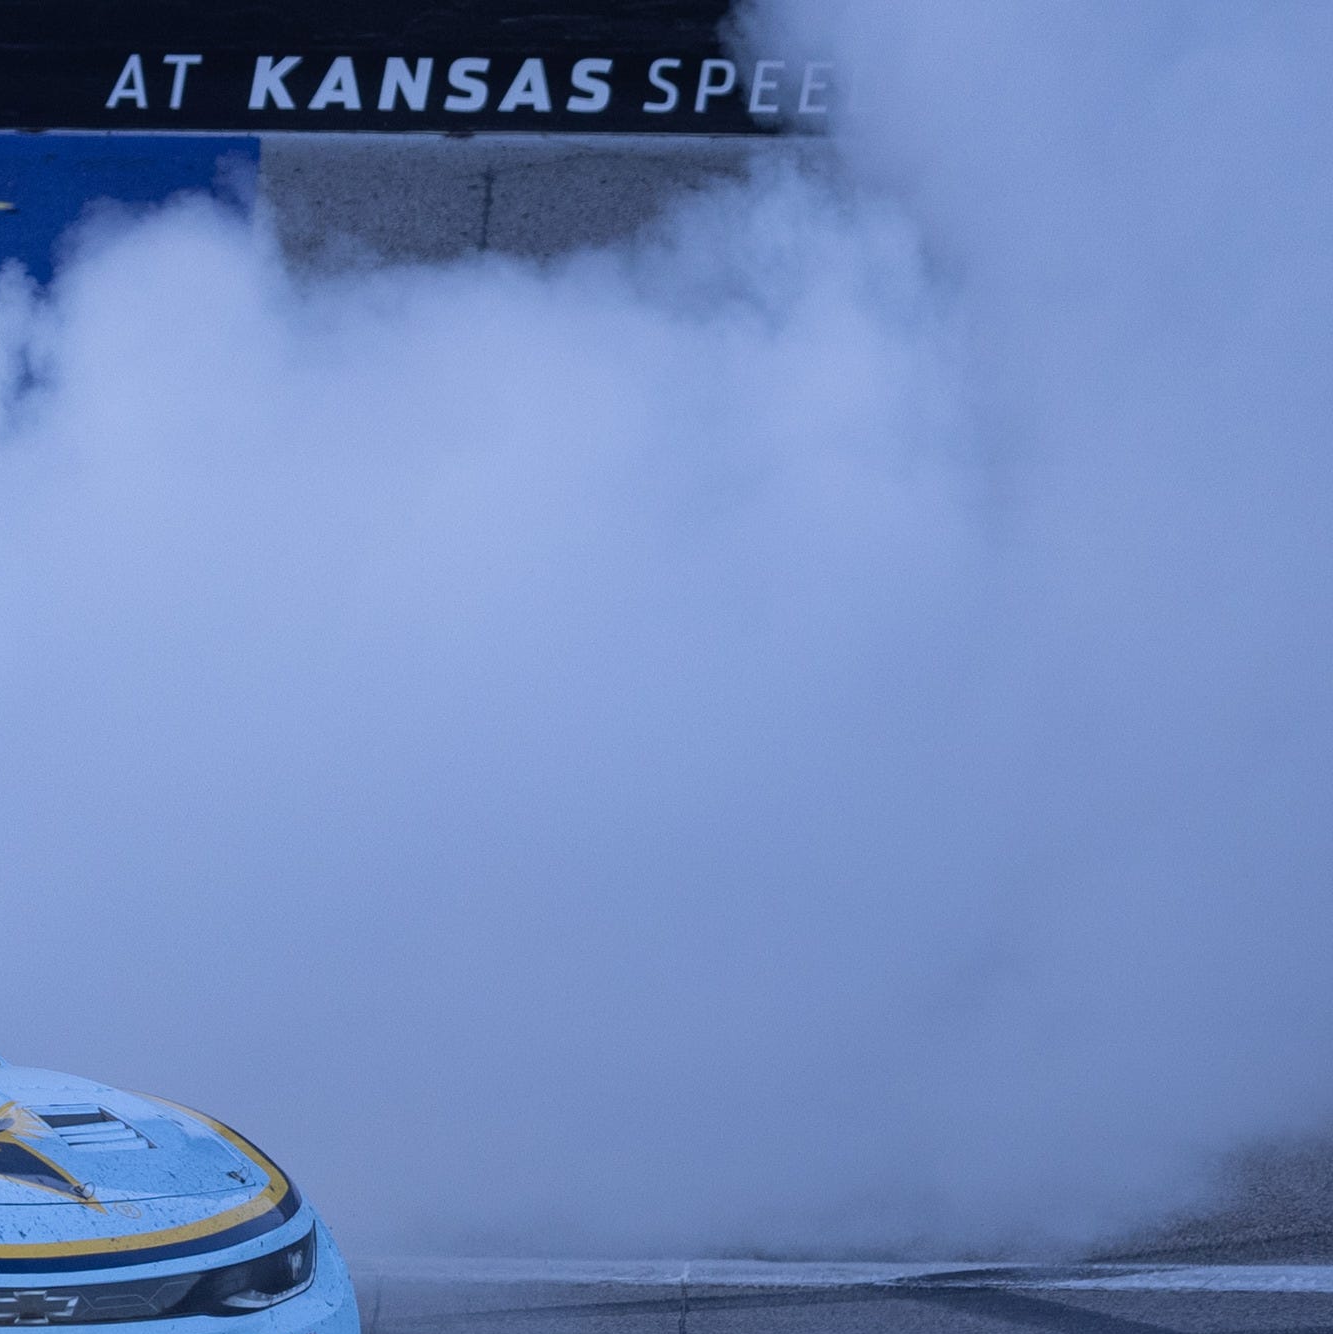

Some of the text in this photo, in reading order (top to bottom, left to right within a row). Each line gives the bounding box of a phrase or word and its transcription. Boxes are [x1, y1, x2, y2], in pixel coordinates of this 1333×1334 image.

[104, 53, 837, 114] AT KANSAS SPEE
